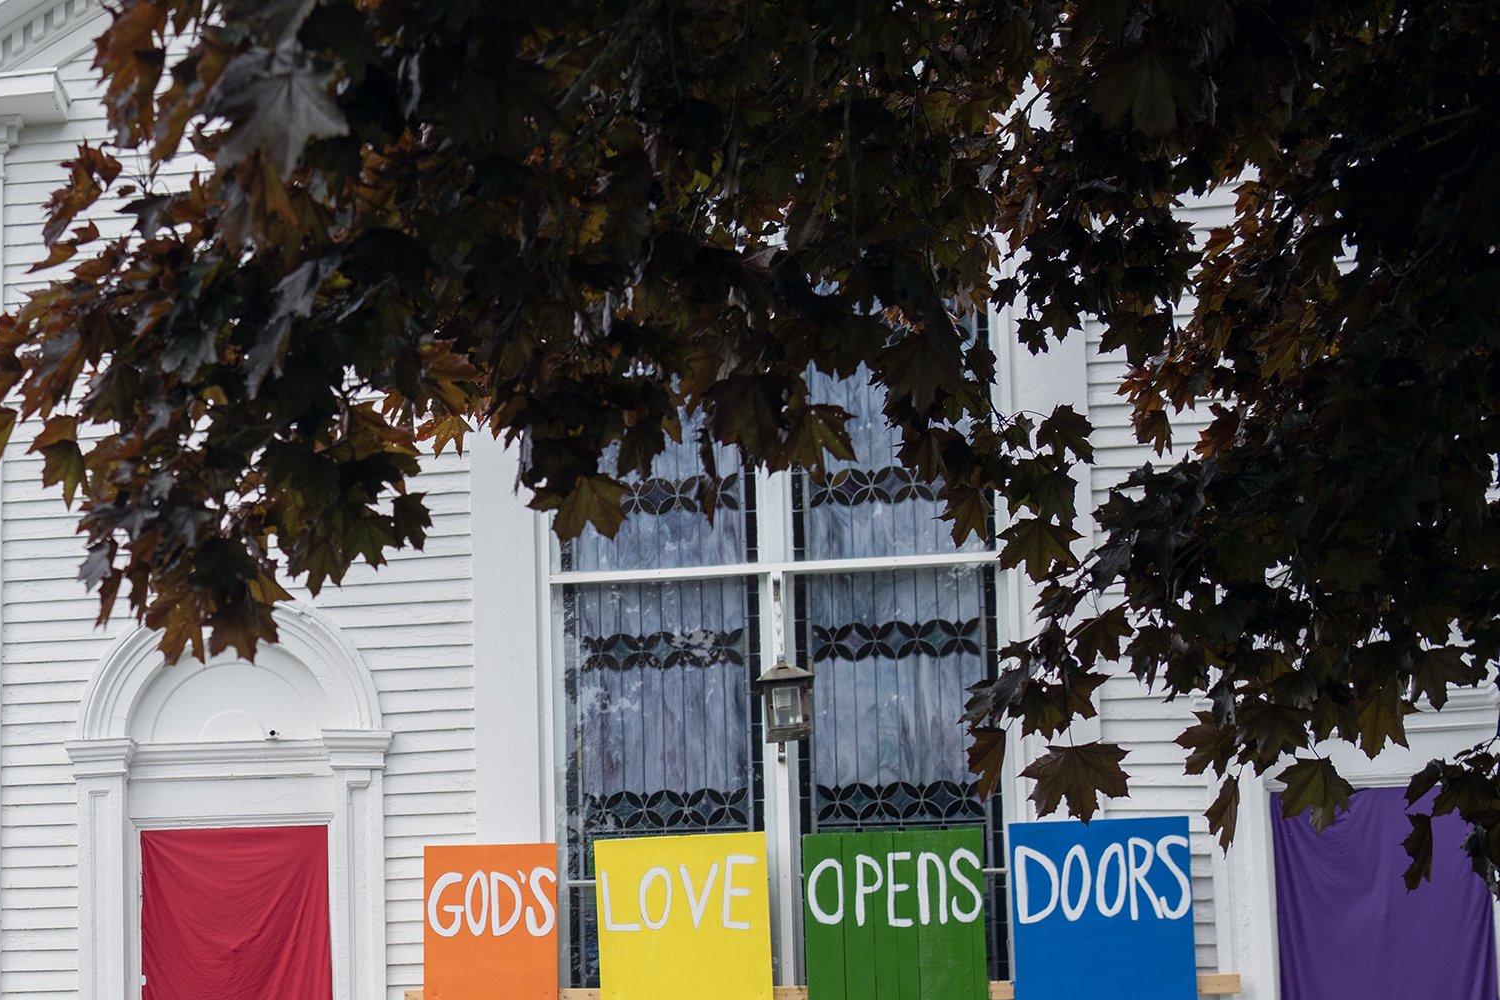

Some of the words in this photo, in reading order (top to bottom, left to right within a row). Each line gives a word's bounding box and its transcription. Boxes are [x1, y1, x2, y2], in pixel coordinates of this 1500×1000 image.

[427, 866, 557, 937] GOD'S
[601, 854, 757, 932] LOVE
[1014, 834, 1192, 925] DOORS
